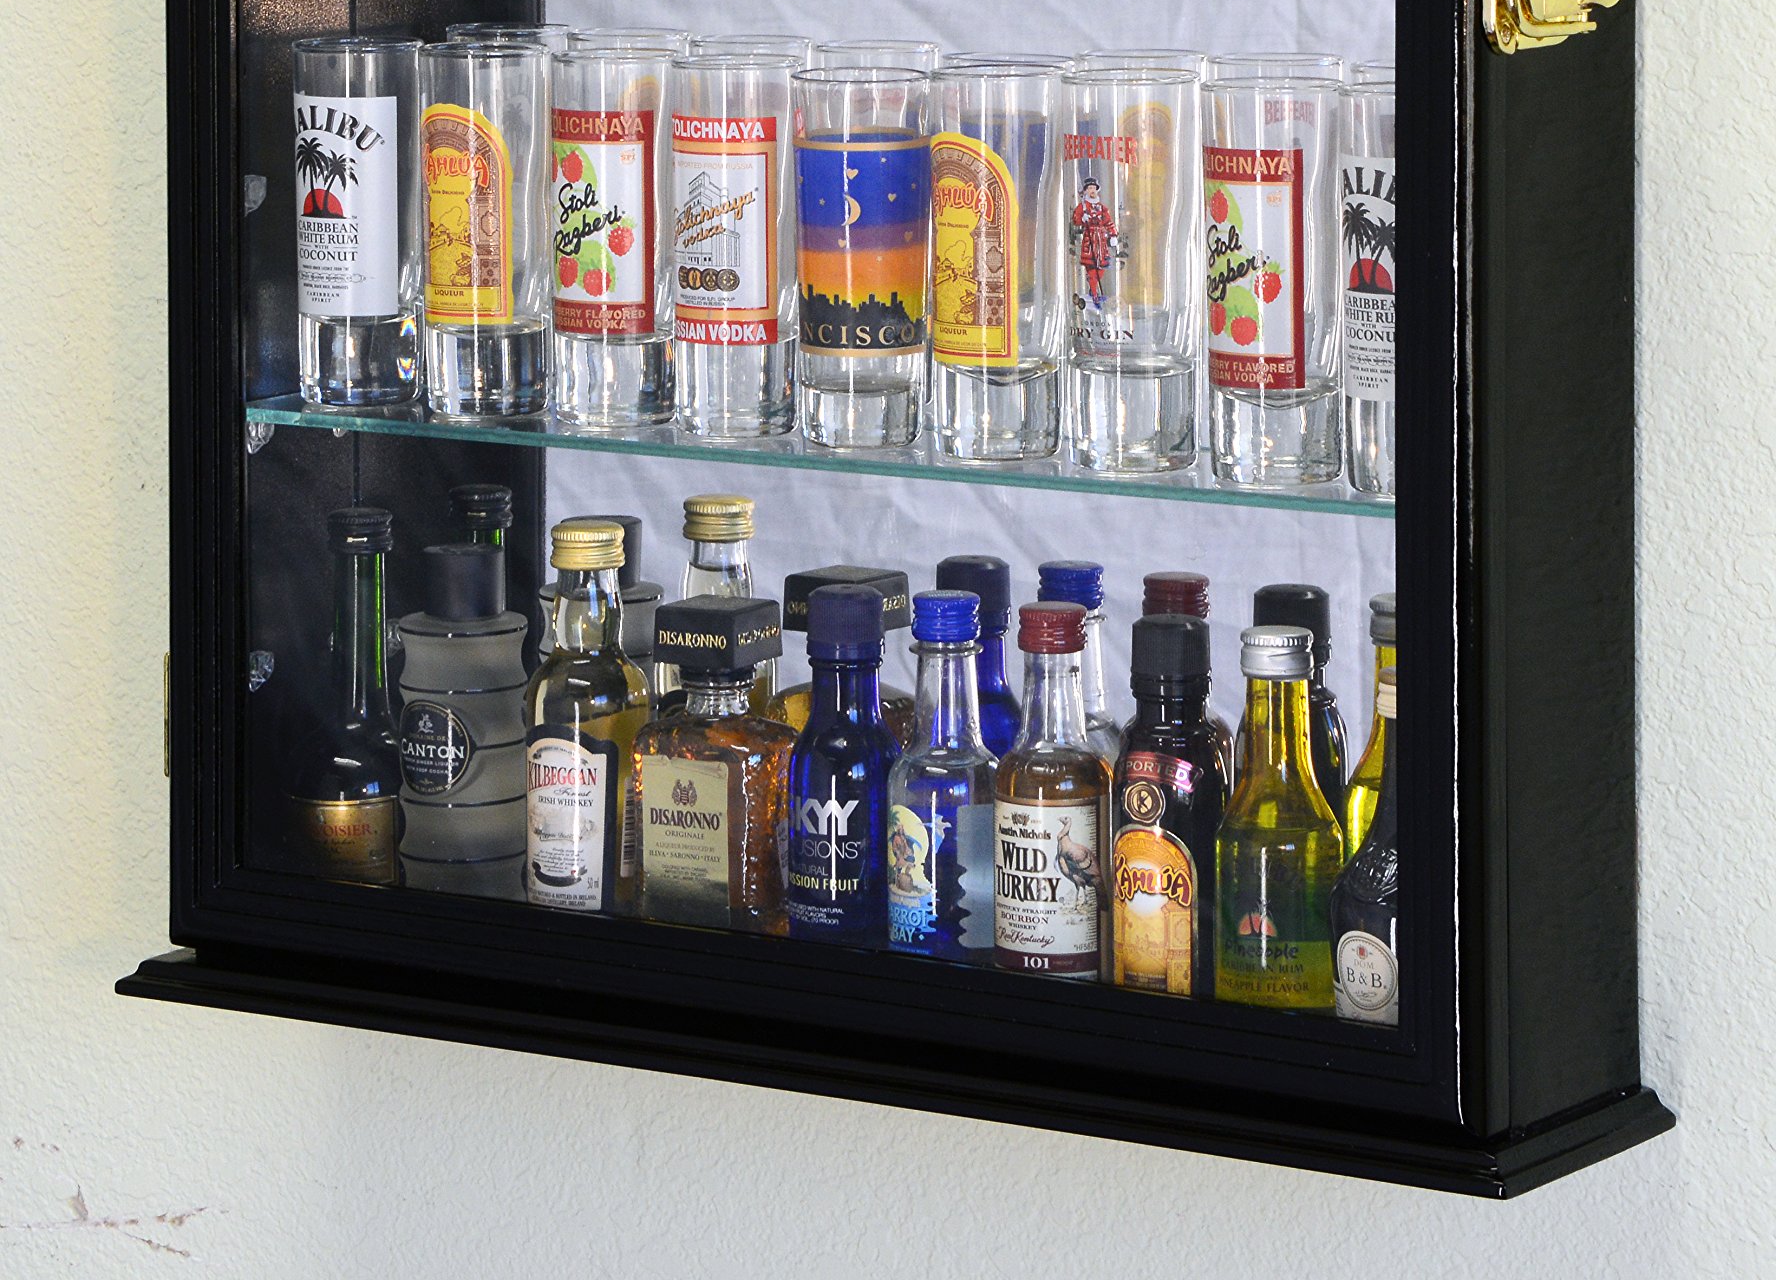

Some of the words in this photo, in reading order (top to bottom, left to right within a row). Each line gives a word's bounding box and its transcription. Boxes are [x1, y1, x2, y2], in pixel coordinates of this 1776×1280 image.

[558, 182, 599, 224] Stoli
[298, 220, 359, 233] CARIBBEAN
[327, 234, 359, 245] RUM
[299, 248, 359, 261] COCONUT
[586, 309, 646, 321] FLAVORED
[587, 320, 627, 331] VODKA
[709, 323, 767, 342] VODKA
[659, 630, 727, 650] DISARONNO
[401, 738, 465, 759] CANTON
[650, 807, 720, 831] DISARONNO
[665, 830, 705, 840] ORIGINALE
[1001, 839, 1048, 874] WILD
[996, 864, 1061, 902] TURKEY
[1001, 911, 1049, 925] BOURBON
[1023, 955, 1050, 969] 101
[1346, 967, 1356, 983] B
